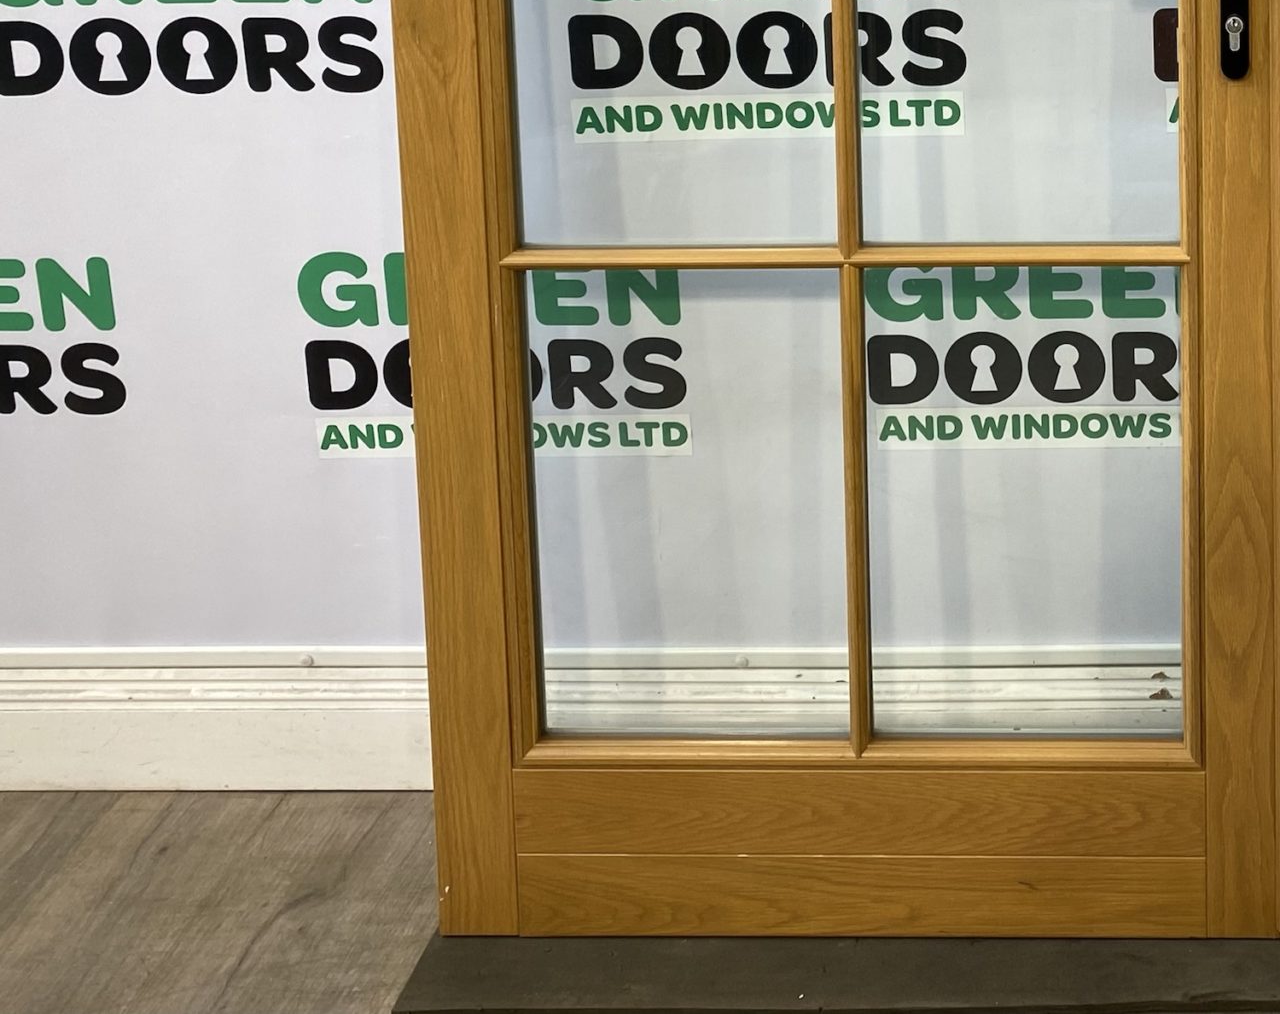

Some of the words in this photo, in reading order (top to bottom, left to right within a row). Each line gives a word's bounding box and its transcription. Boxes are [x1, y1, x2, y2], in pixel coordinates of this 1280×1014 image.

[0, 16, 384, 95] DOORS
[567, 9, 967, 91] DOORS
[576, 104, 663, 135] AND
[889, 99, 961, 127] LTD
[864, 267, 1179, 322] GREE
[320, 424, 403, 451] AND
[618, 421, 689, 448] LTD
[879, 414, 963, 442] AND
[971, 412, 1173, 440] WINDOWS
